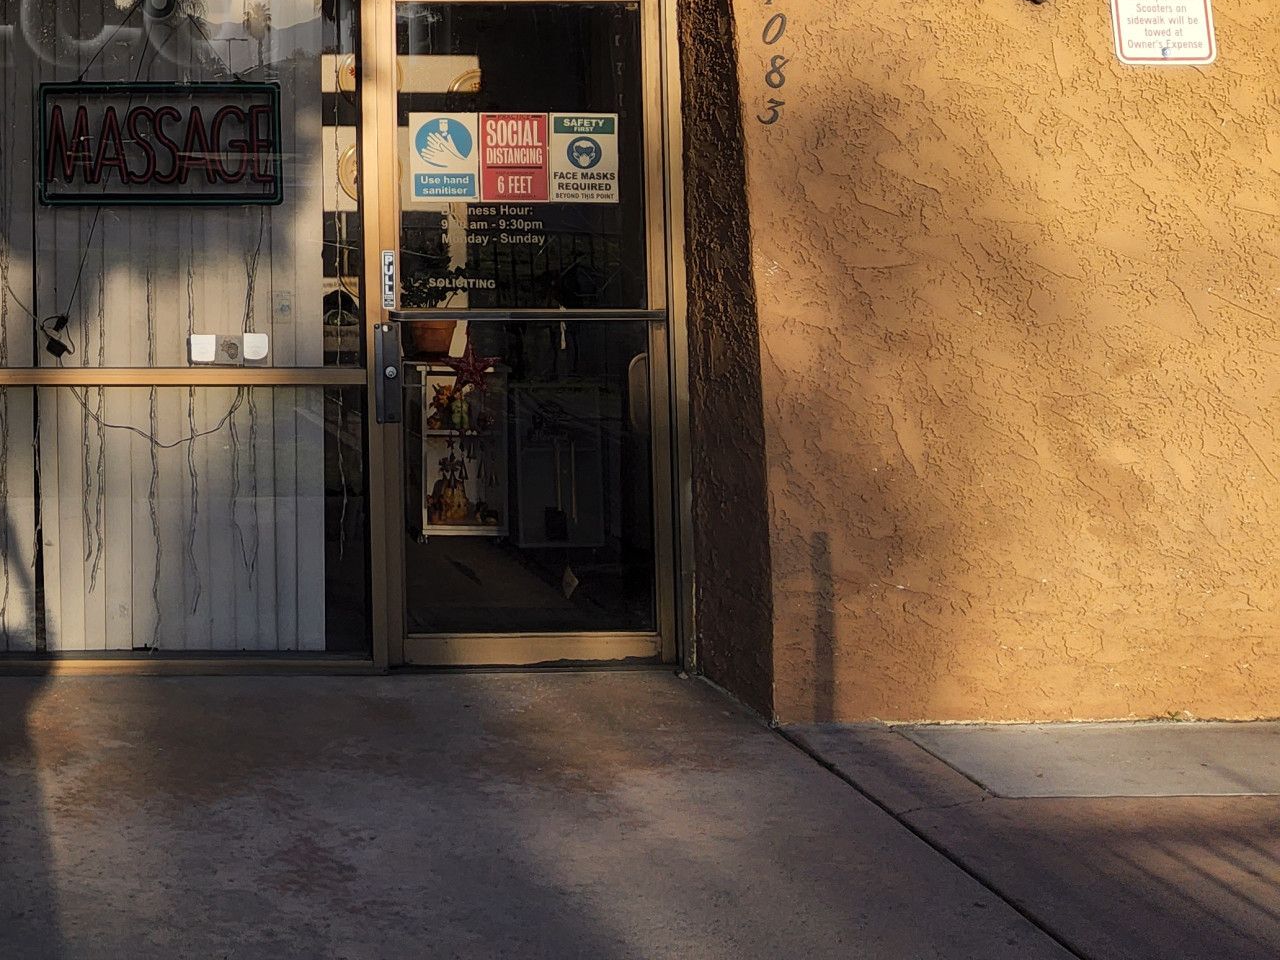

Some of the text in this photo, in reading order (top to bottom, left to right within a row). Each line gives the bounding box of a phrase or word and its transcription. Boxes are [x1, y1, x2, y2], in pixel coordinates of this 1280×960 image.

[1136, 3, 1187, 13] Scooters on
[1127, 15, 1199, 25] sidewalk will be
[1144, 27, 1184, 37] towed at
[1127, 39, 1203, 50] Owner's Expense
[563, 118, 605, 127] SAFETY
[486, 119, 543, 147] SOCIAL
[46, 104, 275, 185] MASSAGE
[486, 147, 543, 165] DISTANCING
[420, 175, 469, 184] Use hand
[553, 171, 616, 181] FACE MASKS
[497, 175, 533, 194] 6 FEET
[557, 182, 612, 191] REQUIRED
[422, 186, 468, 195] sanitiser
[581, 192, 594, 200] THIS
[596, 192, 615, 200] POINT
[441, 204, 533, 215] Bness Hour:
[499, 219, 543, 231] 9:30pm
[500, 232, 546, 245] Sunday
[384, 254, 394, 294] PULL
[428, 277, 496, 289] SOLICITING
